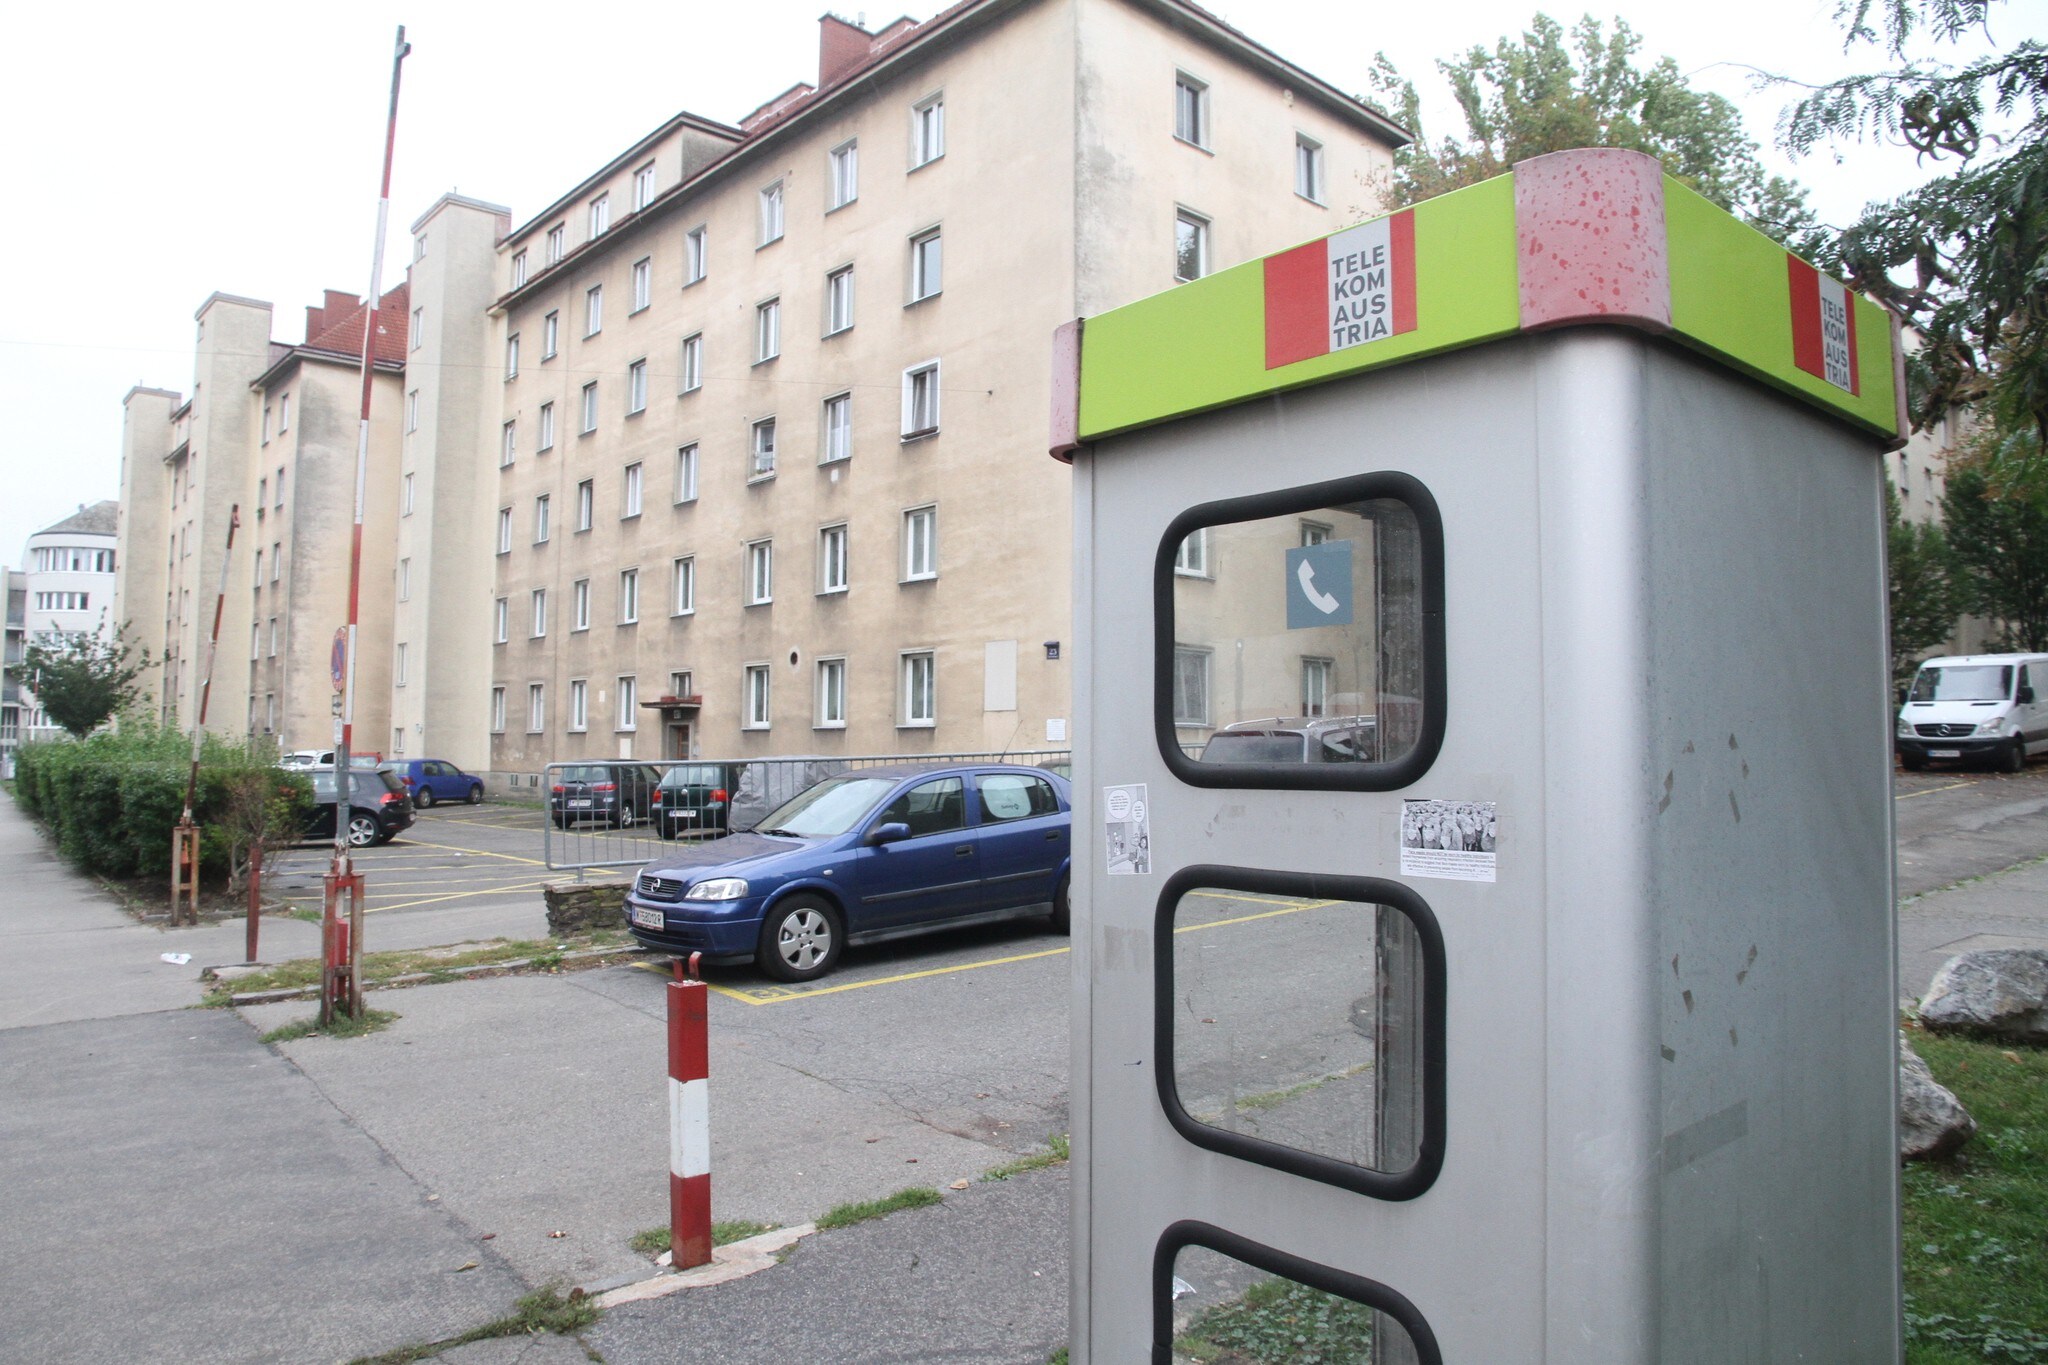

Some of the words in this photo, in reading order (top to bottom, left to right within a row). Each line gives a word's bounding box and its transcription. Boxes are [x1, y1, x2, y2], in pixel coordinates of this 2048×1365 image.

[1332, 245, 1385, 278] TELE
[1334, 269, 1385, 301] KOM
[1334, 294, 1386, 326] AUS
[1822, 297, 1844, 326] TELE
[1333, 317, 1388, 348] TRIA
[1824, 321, 1846, 346] KOM
[1825, 346, 1848, 368] AUS
[1826, 363, 1849, 390] TRIA
